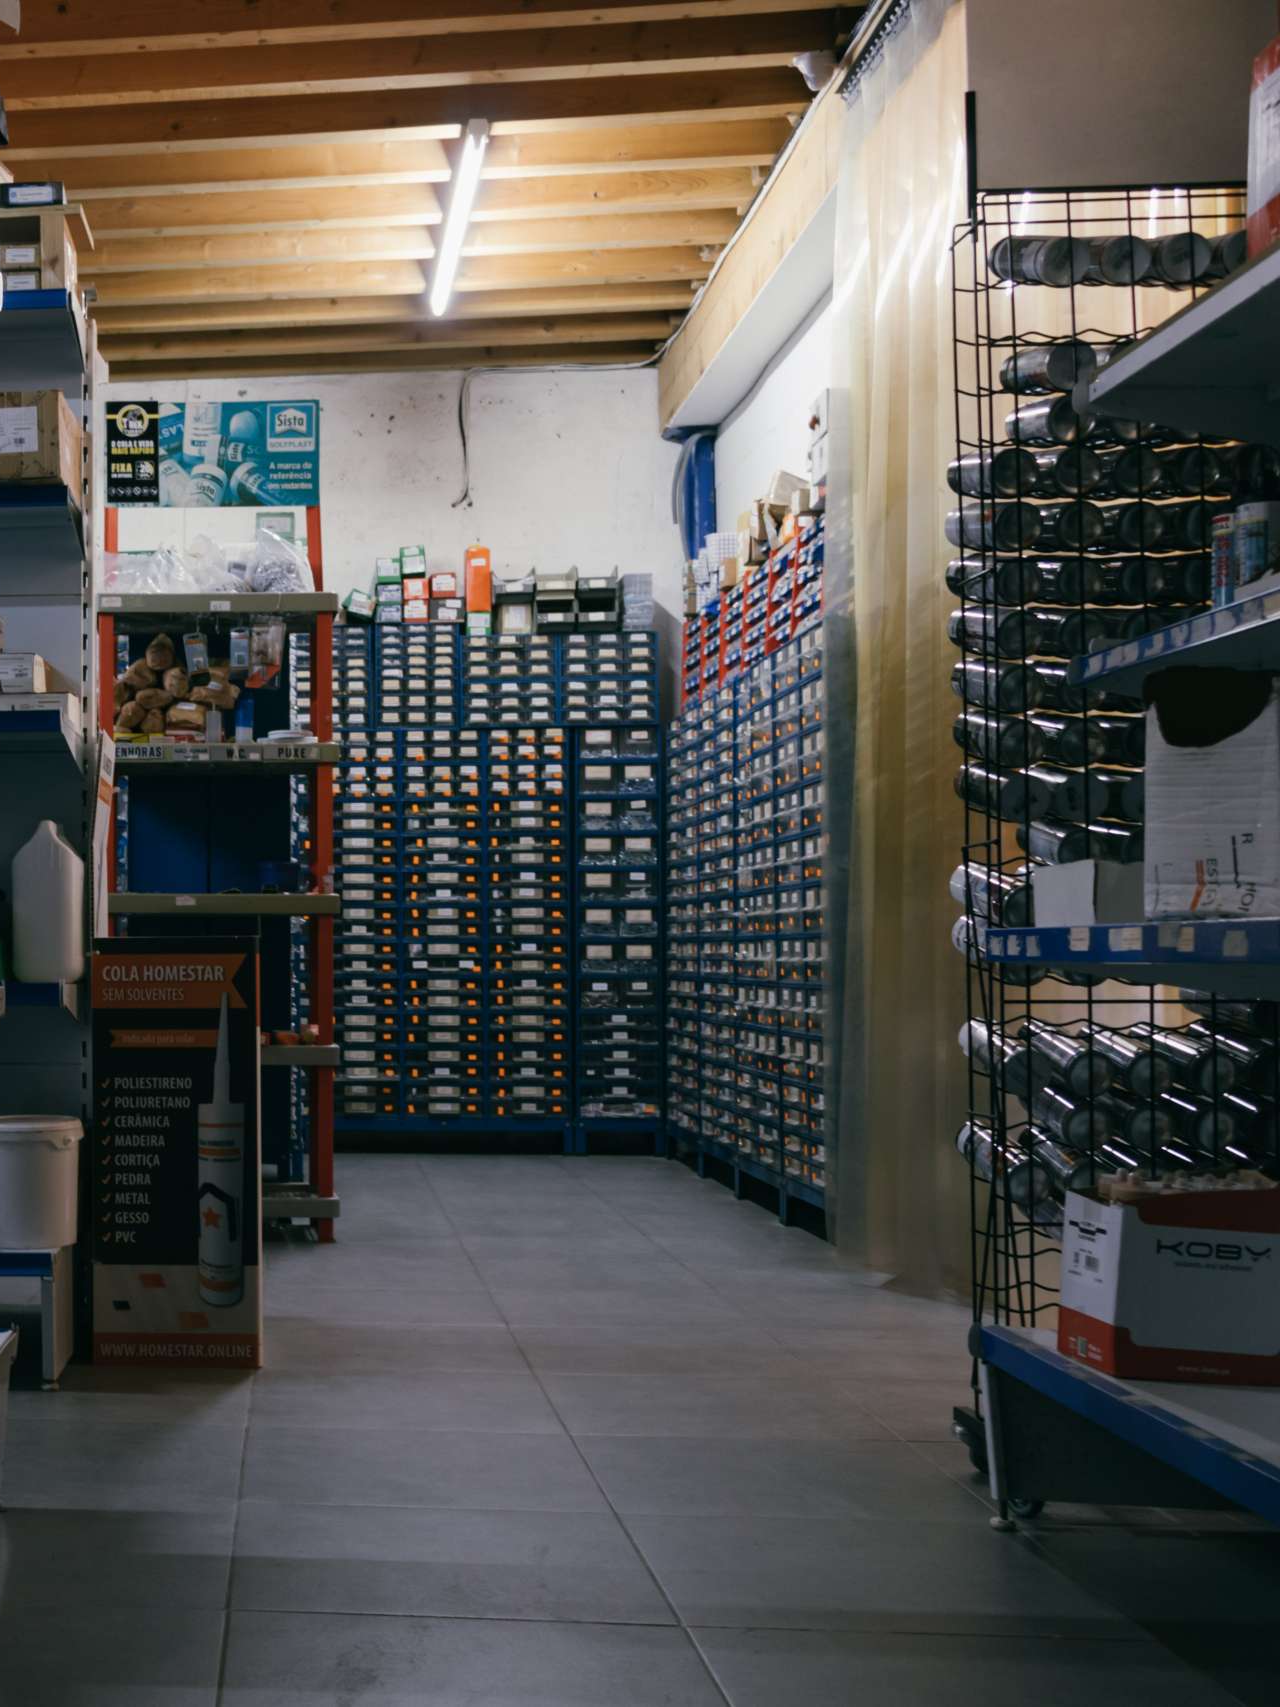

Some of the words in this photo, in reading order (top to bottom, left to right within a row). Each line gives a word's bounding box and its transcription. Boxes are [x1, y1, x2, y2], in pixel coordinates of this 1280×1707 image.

[277, 414, 304, 426] Sista
[115, 746, 162, 758] ENHORAS
[278, 747, 306, 759] PUXE
[102, 965, 139, 982] COLA
[143, 965, 224, 982] HOMESTAR
[102, 987, 125, 1001] SEM
[127, 987, 184, 1001] SOLVENTES
[114, 1076, 193, 1090] POLIESTIRENO
[114, 1096, 192, 1109] POLIURETANO
[114, 1113, 171, 1128] CERÂMICA
[114, 1135, 166, 1147] MADEIRA
[114, 1153, 161, 1168] CORTIÇA
[114, 1172, 152, 1185] PEDRA
[114, 1192, 152, 1205] METAL
[114, 1211, 150, 1224] GESSO
[115, 1231, 137, 1243] PVC
[1156, 1239, 1272, 1262] KOBY
[99, 1343, 253, 1358] WWW.HOMESTAR.ONLINE
